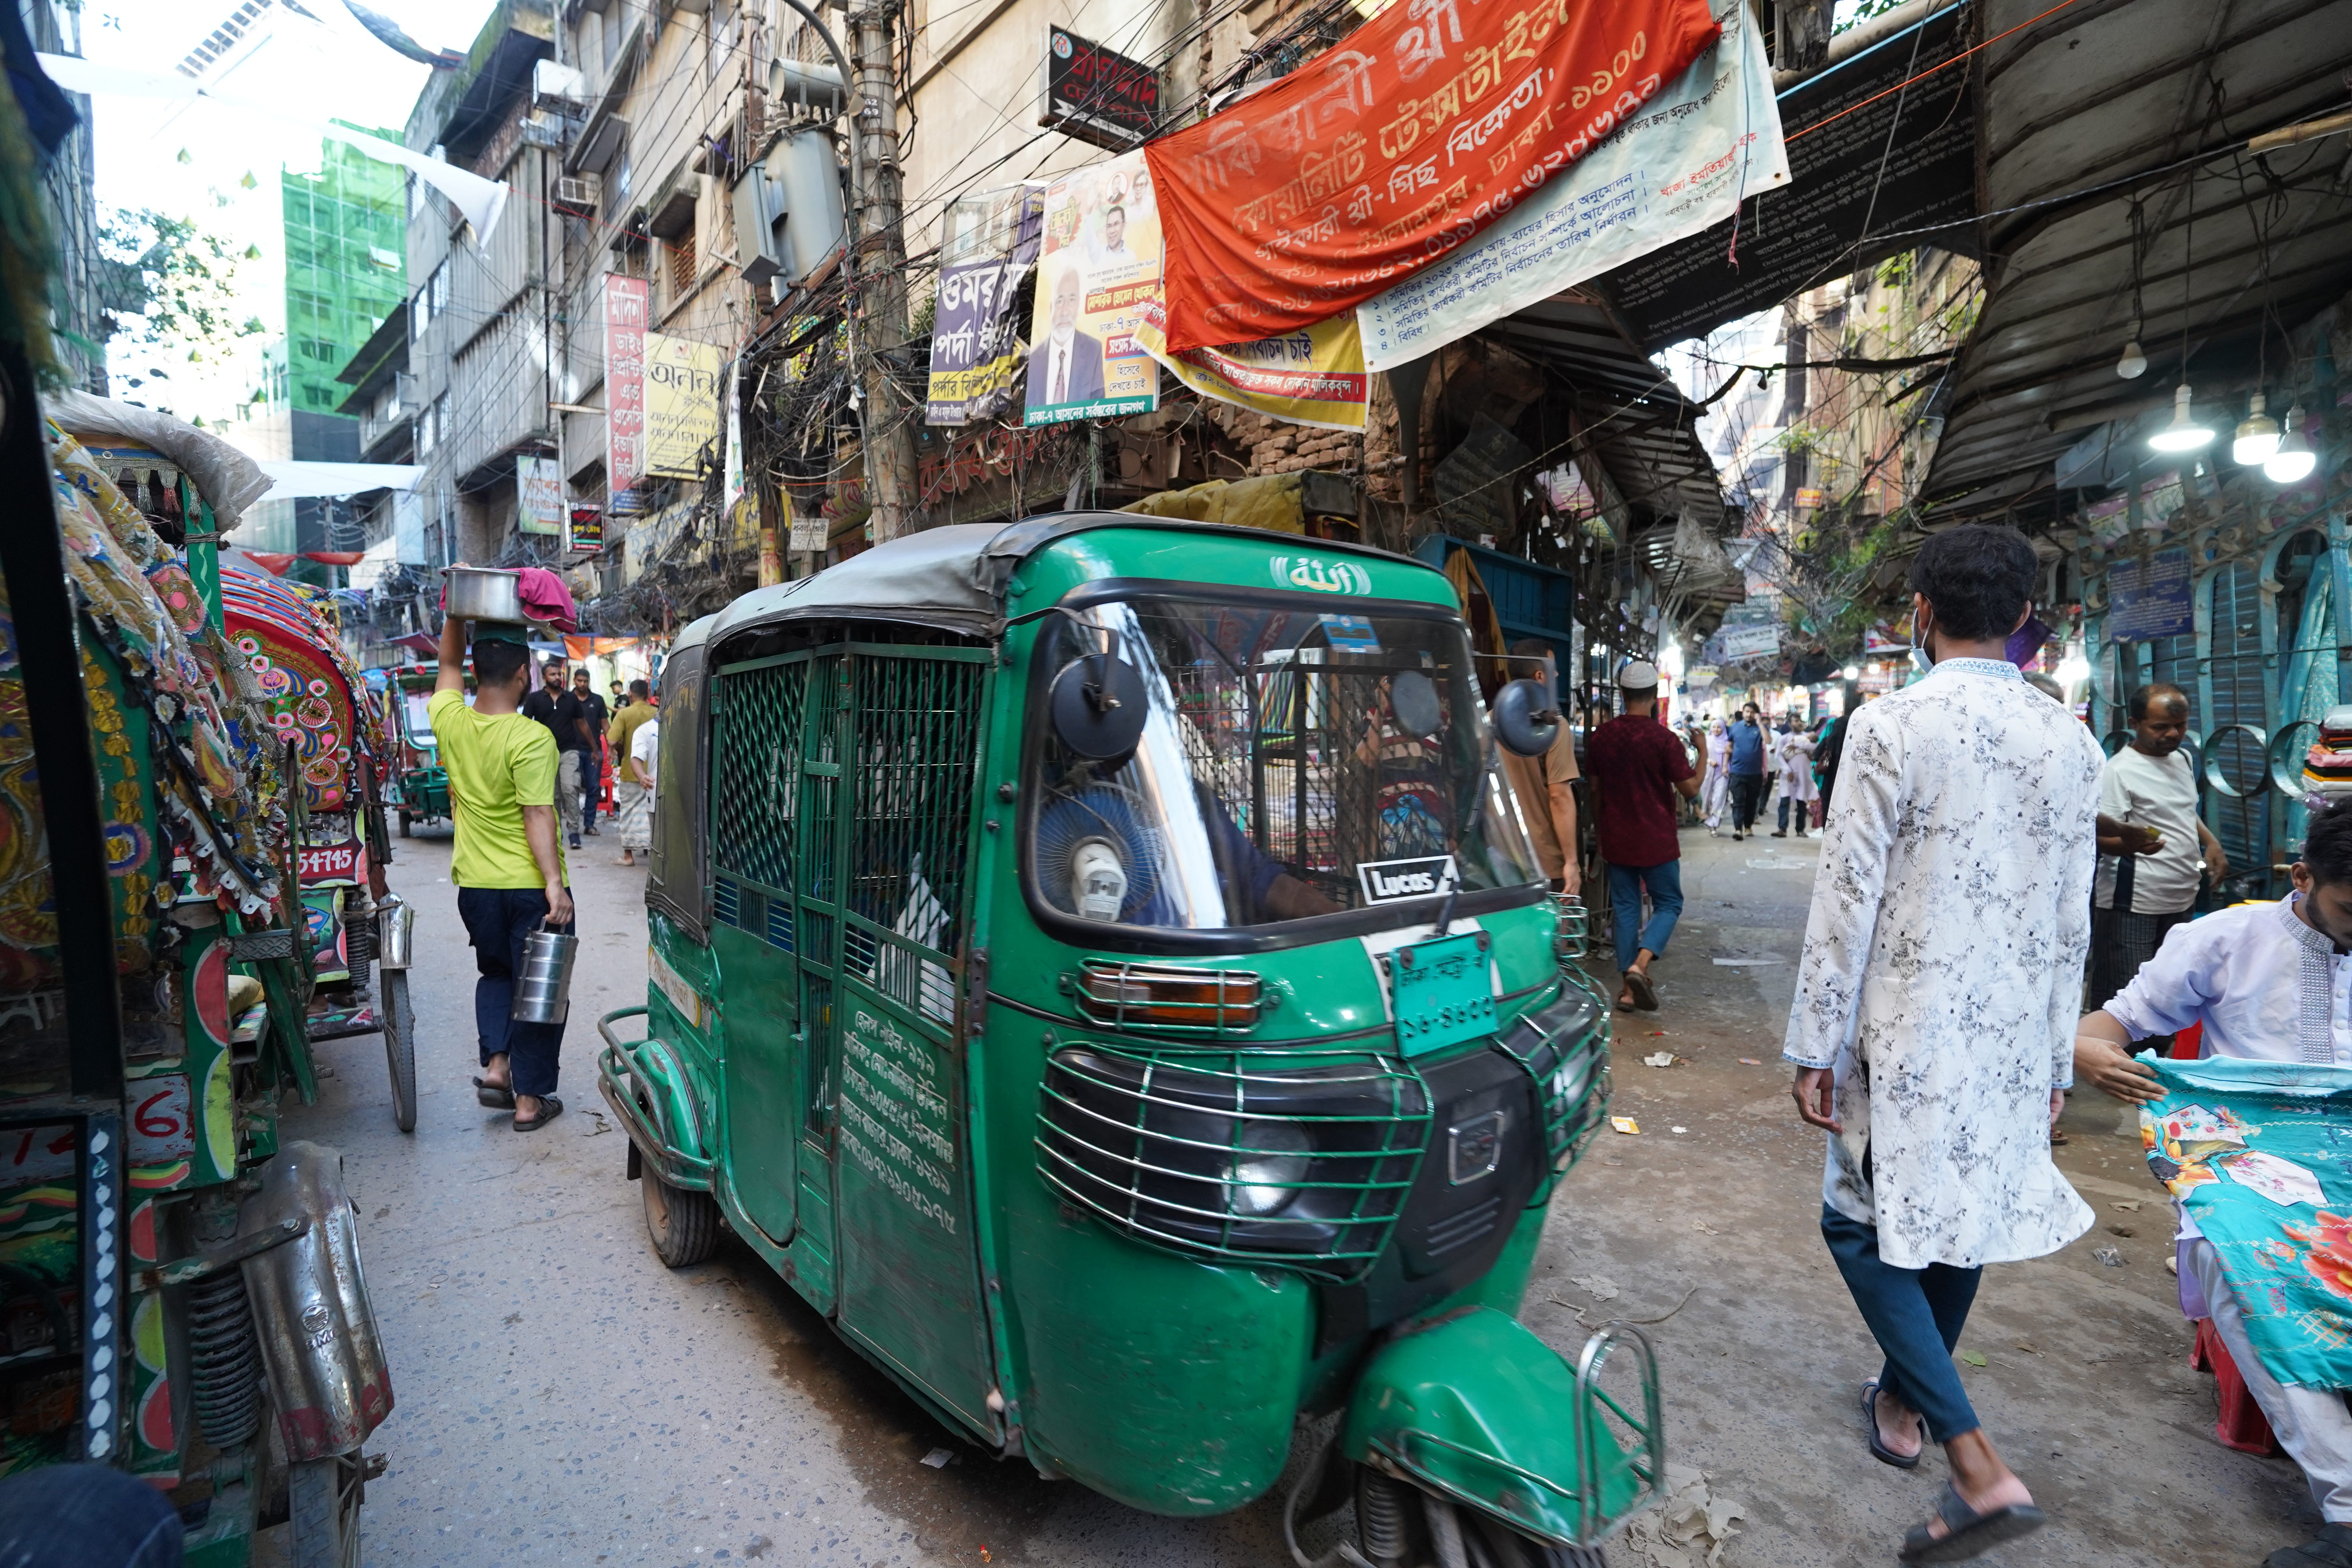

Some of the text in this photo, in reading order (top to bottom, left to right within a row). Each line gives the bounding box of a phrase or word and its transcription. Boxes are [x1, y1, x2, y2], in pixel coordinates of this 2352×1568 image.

[1659, 179, 1685, 197] খাজা
[1256, 205, 1340, 261] পাইকারী
[1386, 277, 1425, 304] সমিতির
[1423, 266, 1453, 285] ২০২৩
[1452, 248, 1484, 268] সালের
[1577, 173, 1632, 204] অনুমোদন
[1392, 294, 1426, 314] সমিতির
[1424, 273, 1461, 298] কার্যকরী
[1461, 257, 1498, 278] কমিটির
[1500, 239, 1535, 263] নির্বাচন
[1579, 189, 1635, 220] আলোচনা
[1395, 307, 1429, 328] সমিতির
[1431, 287, 1465, 311] কার্যকরী
[1467, 271, 1502, 293] কমিটির
[1504, 246, 1553, 276] নির্বাচনের
[1555, 227, 1591, 249] তারিখ
[1594, 207, 1637, 234] নির্ধারন
[609, 280, 644, 328] মদিনা
[1113, 289, 1133, 307] হোসেন
[1134, 284, 1156, 303] খোকন
[935, 319, 975, 365] পর্দা
[1109, 338, 1130, 354] সংসদ
[1397, 326, 1423, 343] বিবিধ
[1287, 330, 1314, 367] চাই
[1117, 364, 1140, 376] হিসেবে
[933, 374, 958, 398] পর্দার
[1109, 377, 1147, 392] দেখতে চাই
[1264, 374, 1283, 388] সকল
[1283, 377, 1311, 392] দোকান
[1311, 374, 1352, 399] মালিকবৃন্দ
[1055, 407, 1084, 422] আসনের
[1085, 401, 1117, 418] সর্বস্তরের
[1118, 400, 1145, 415] জনগণ
[1370, 871, 1435, 897] Lucas
